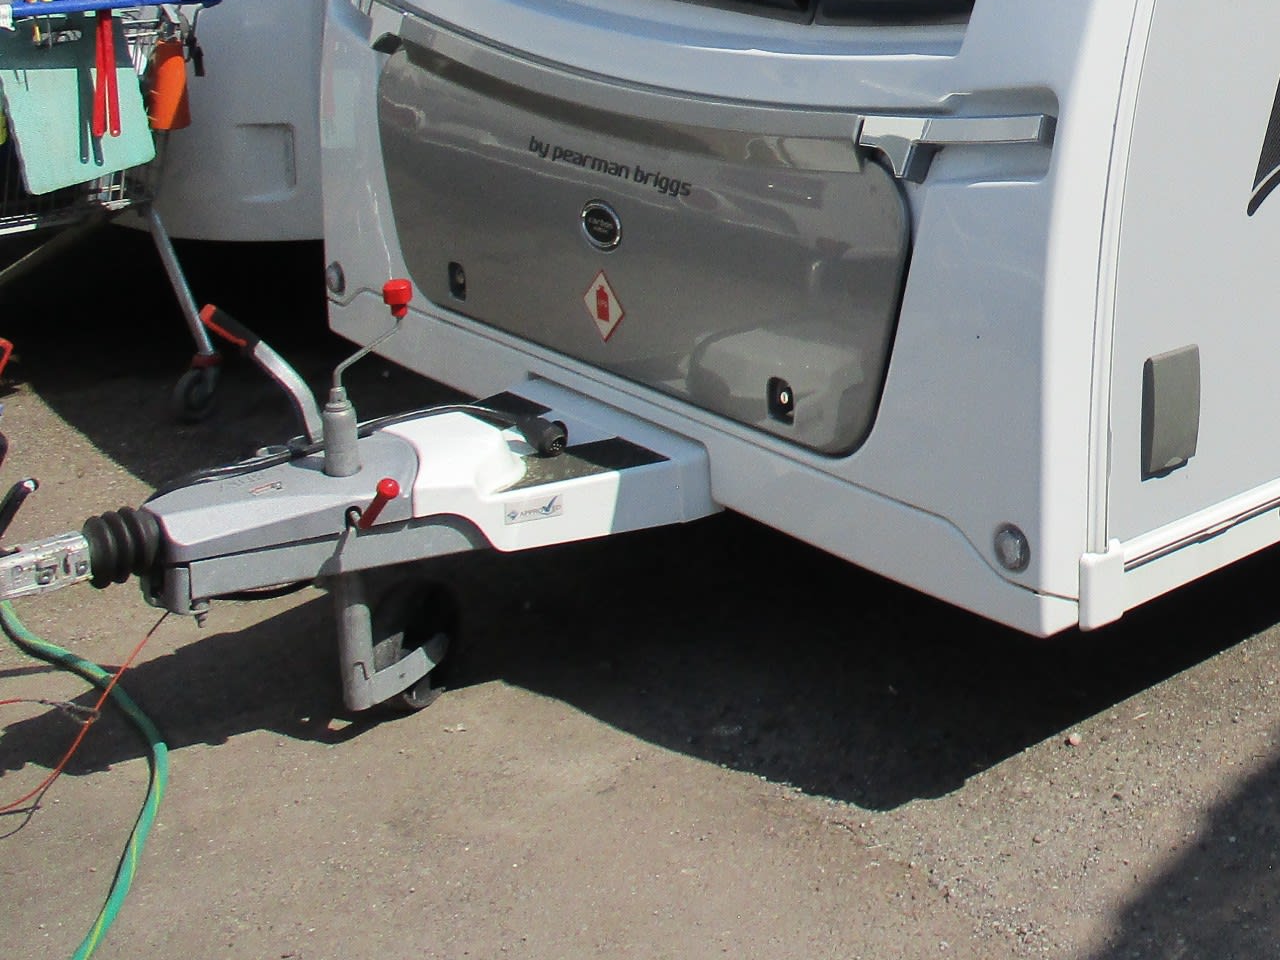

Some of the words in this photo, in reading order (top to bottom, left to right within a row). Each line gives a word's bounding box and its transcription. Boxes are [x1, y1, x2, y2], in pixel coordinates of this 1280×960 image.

[529, 135, 550, 158] by
[551, 145, 630, 179] pearman
[633, 164, 692, 197] briggs
